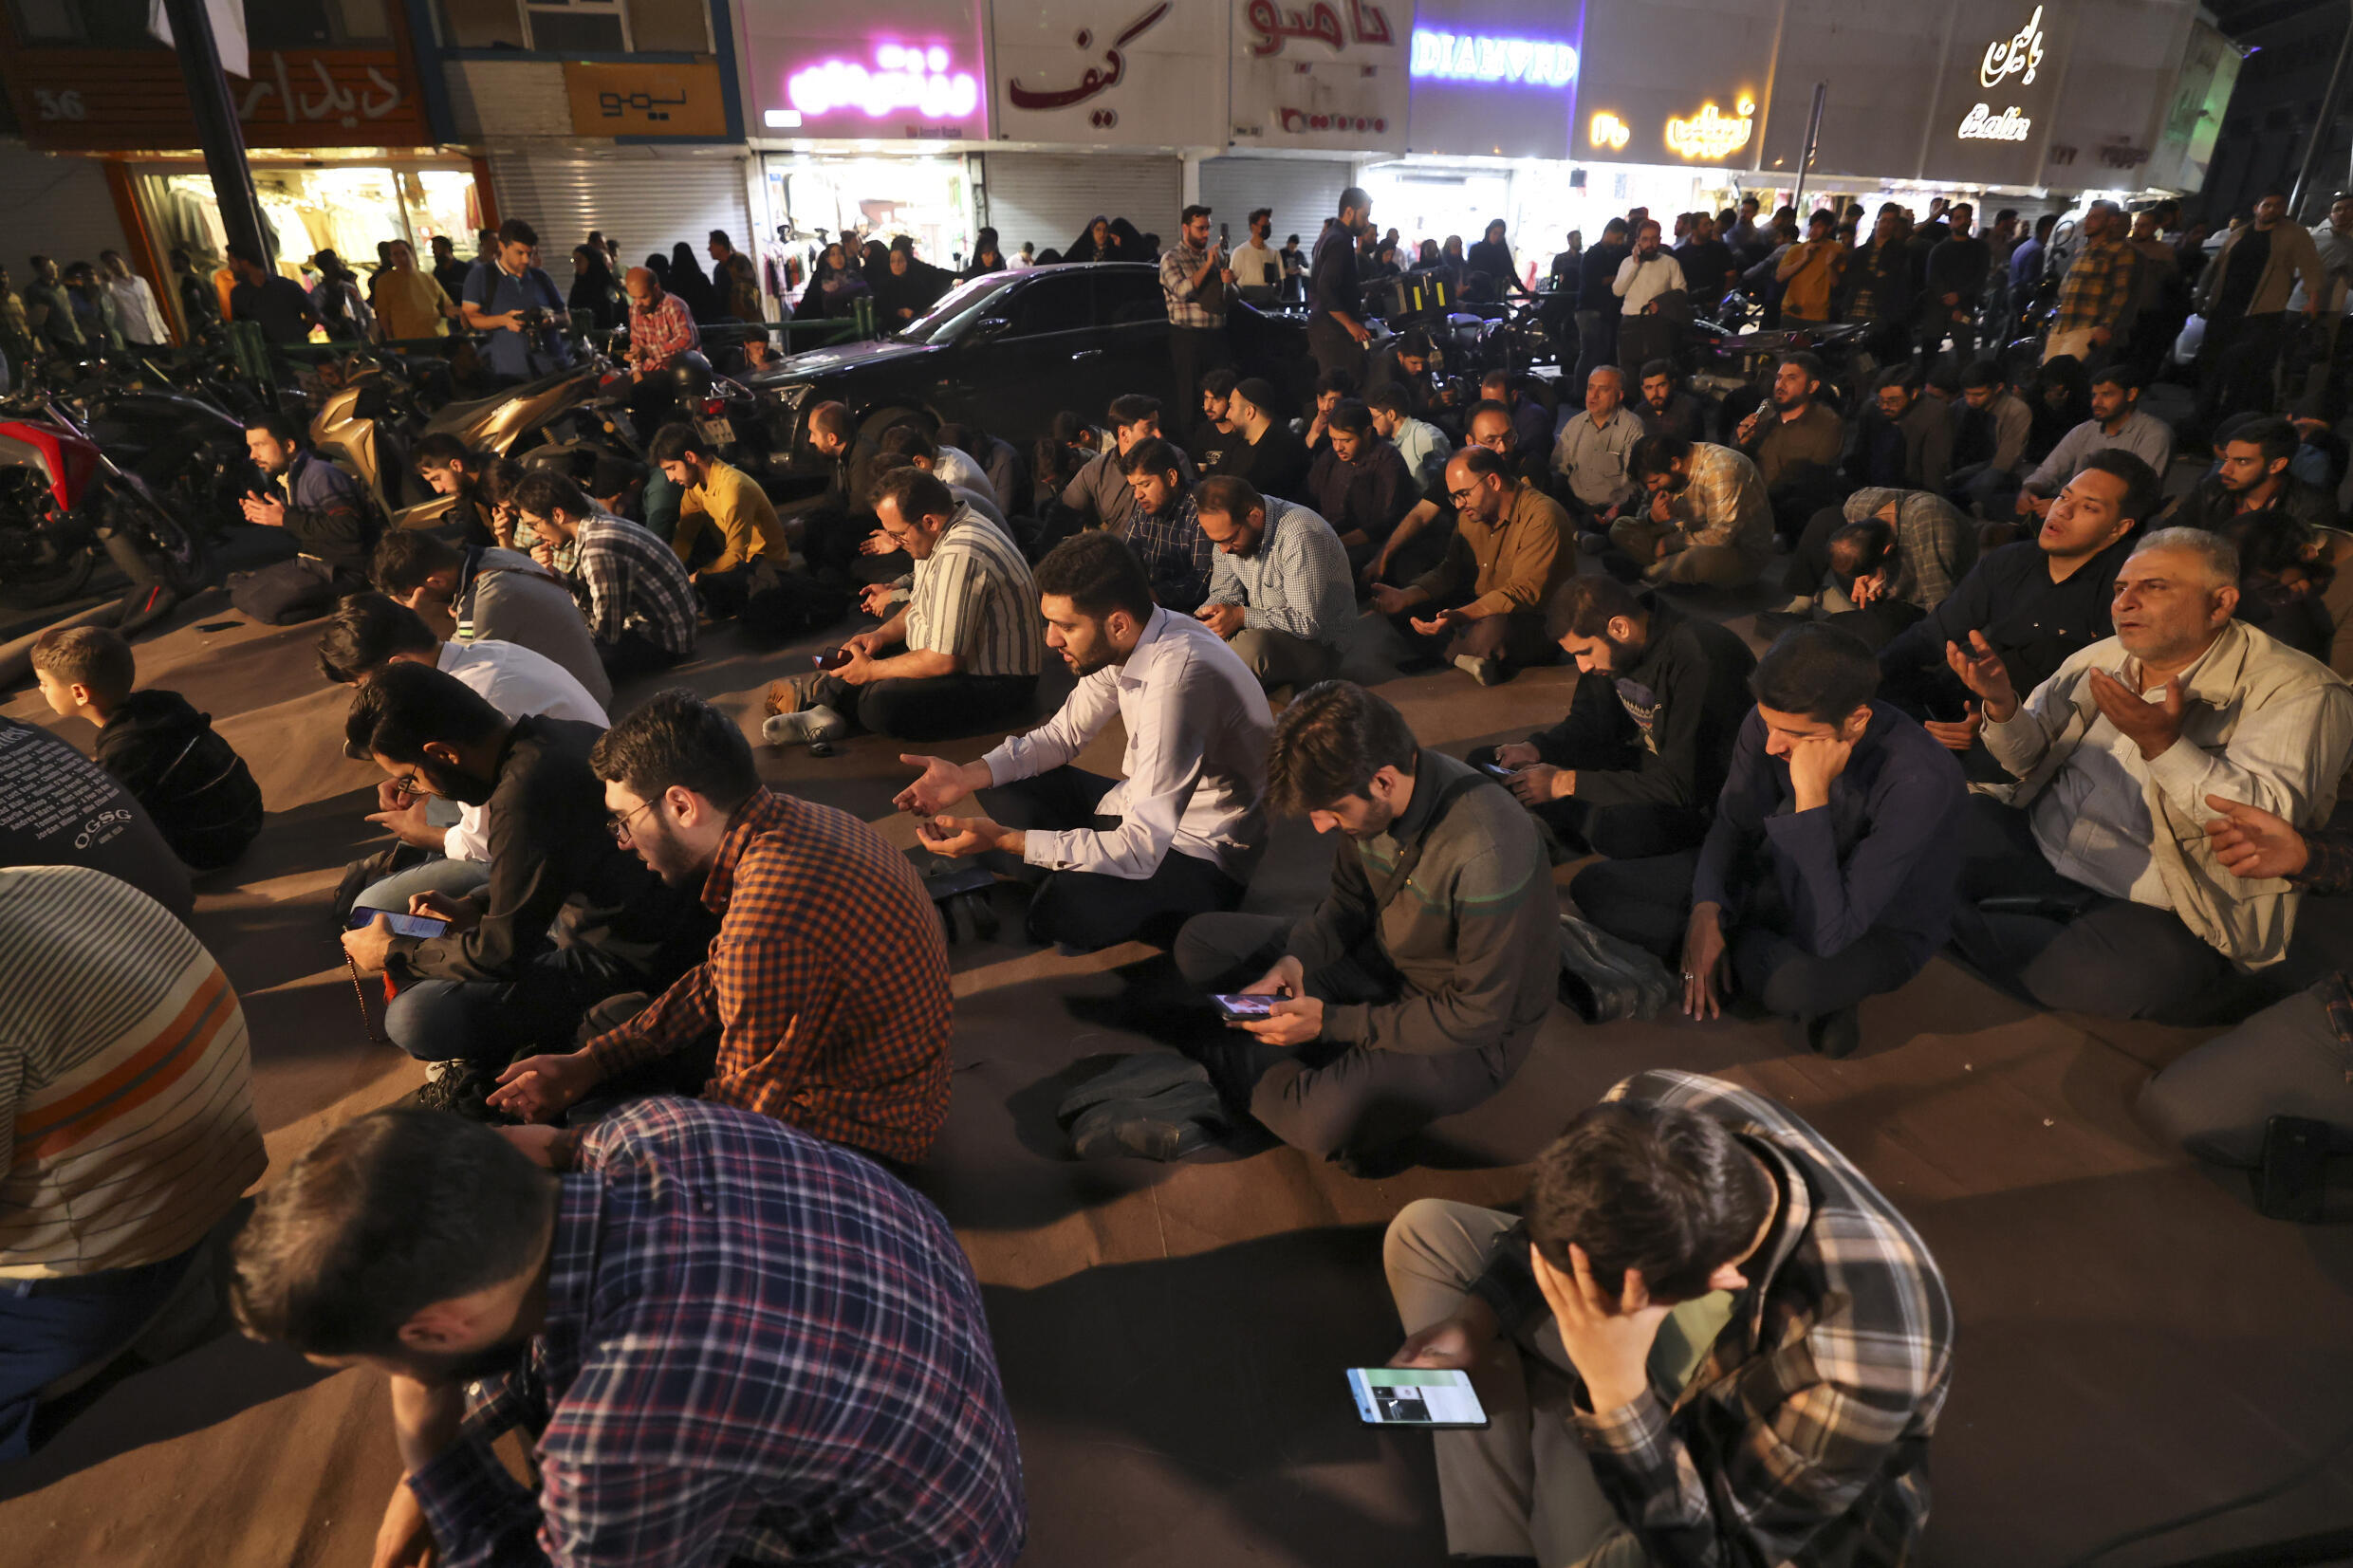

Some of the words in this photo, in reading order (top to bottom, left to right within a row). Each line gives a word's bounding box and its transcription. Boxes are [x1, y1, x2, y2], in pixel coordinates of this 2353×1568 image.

[1009, 2, 1170, 126] کیف
[238, 51, 401, 128] دیدار
[599, 88, 686, 120] لیمو
[1958, 102, 2031, 141] Balin
[75, 809, 133, 849] OGSG
